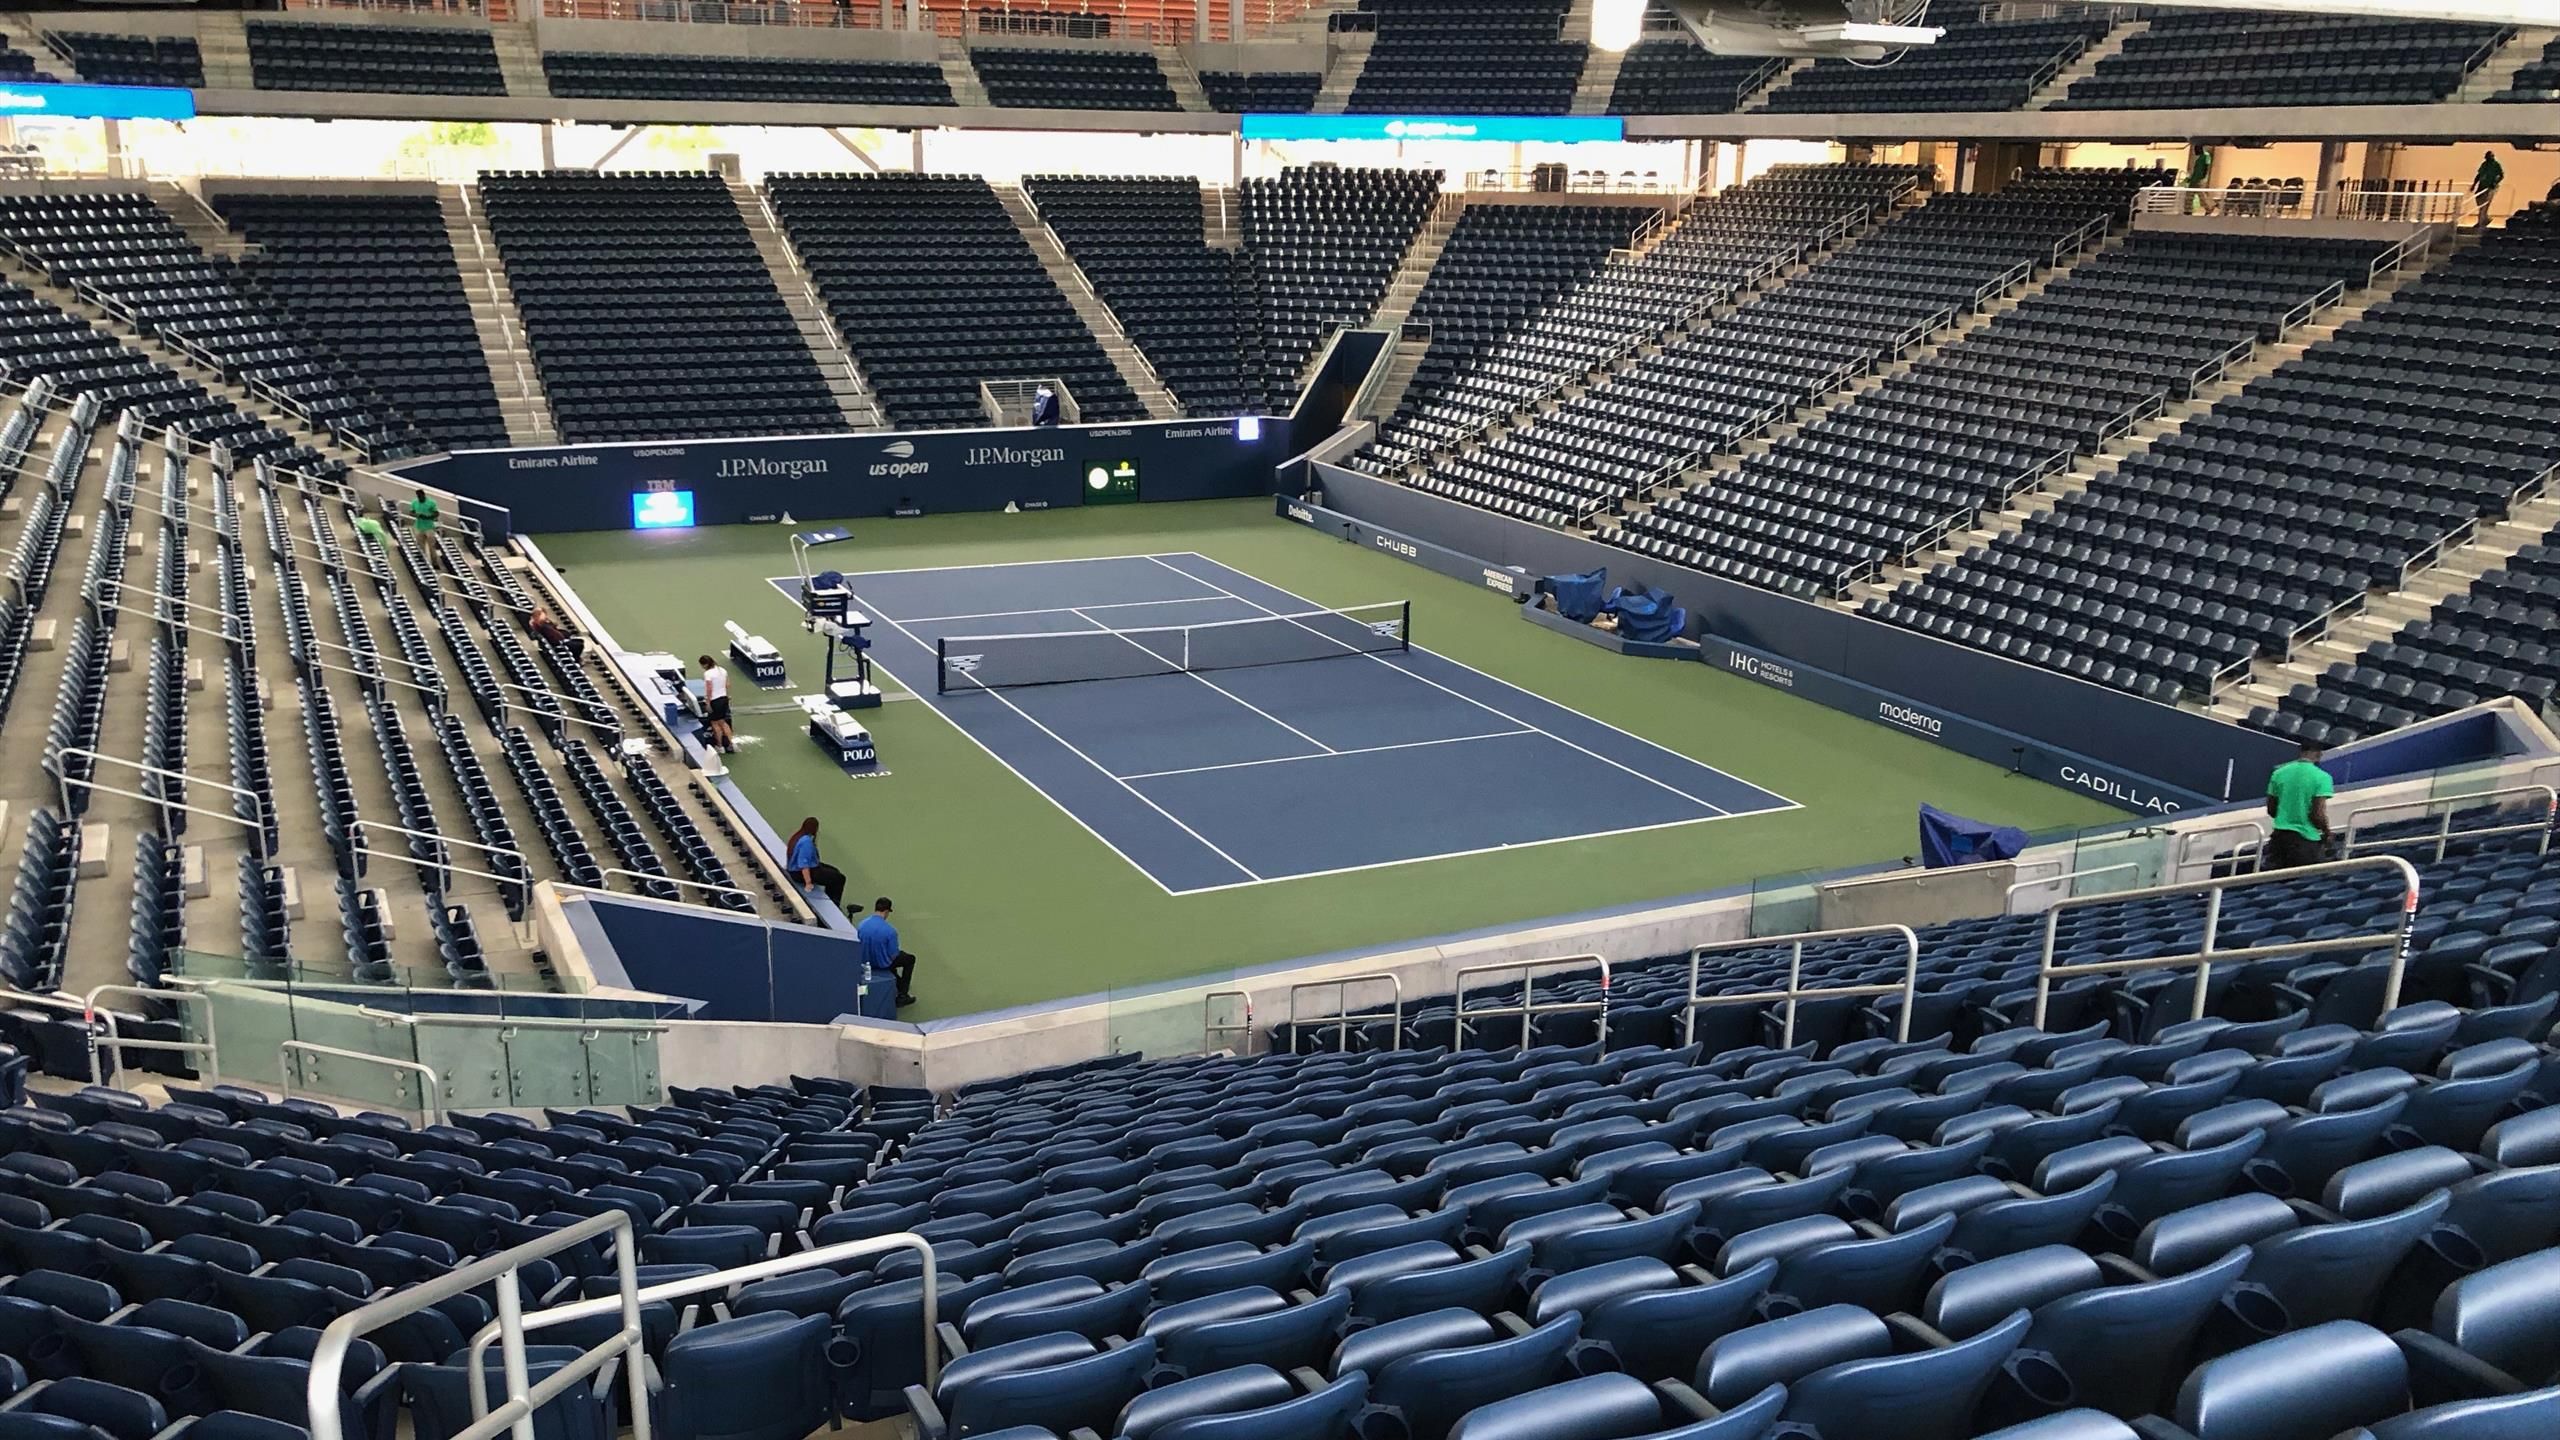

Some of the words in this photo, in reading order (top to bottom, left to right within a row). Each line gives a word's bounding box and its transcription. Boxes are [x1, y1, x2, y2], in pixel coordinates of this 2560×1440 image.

[1089, 429, 1132, 438] USOPEN.ORG
[1165, 428, 1202, 439] Emirates
[1204, 426, 1233, 437] Airline
[633, 449, 686, 458] USOPEN.ORG
[965, 447, 1065, 468] J.P.Morgan
[509, 456, 558, 469] Emirates
[561, 455, 599, 467] Airline
[716, 458, 829, 480] J.P.Morgan
[869, 464, 888, 476] us
[889, 462, 929, 479] open
[647, 479, 676, 492] IBM
[1376, 535, 1417, 558] CHUBB
[1483, 568, 1514, 585] AMERICAN
[1486, 577, 1513, 593] EXPRESS
[756, 665, 785, 678] POLO
[1730, 651, 1760, 675] IHG
[1760, 661, 1789, 677] HOTELS
[1760, 670, 1793, 687] RESORTS
[1880, 701, 1942, 733] moderna
[843, 748, 875, 762] POLO
